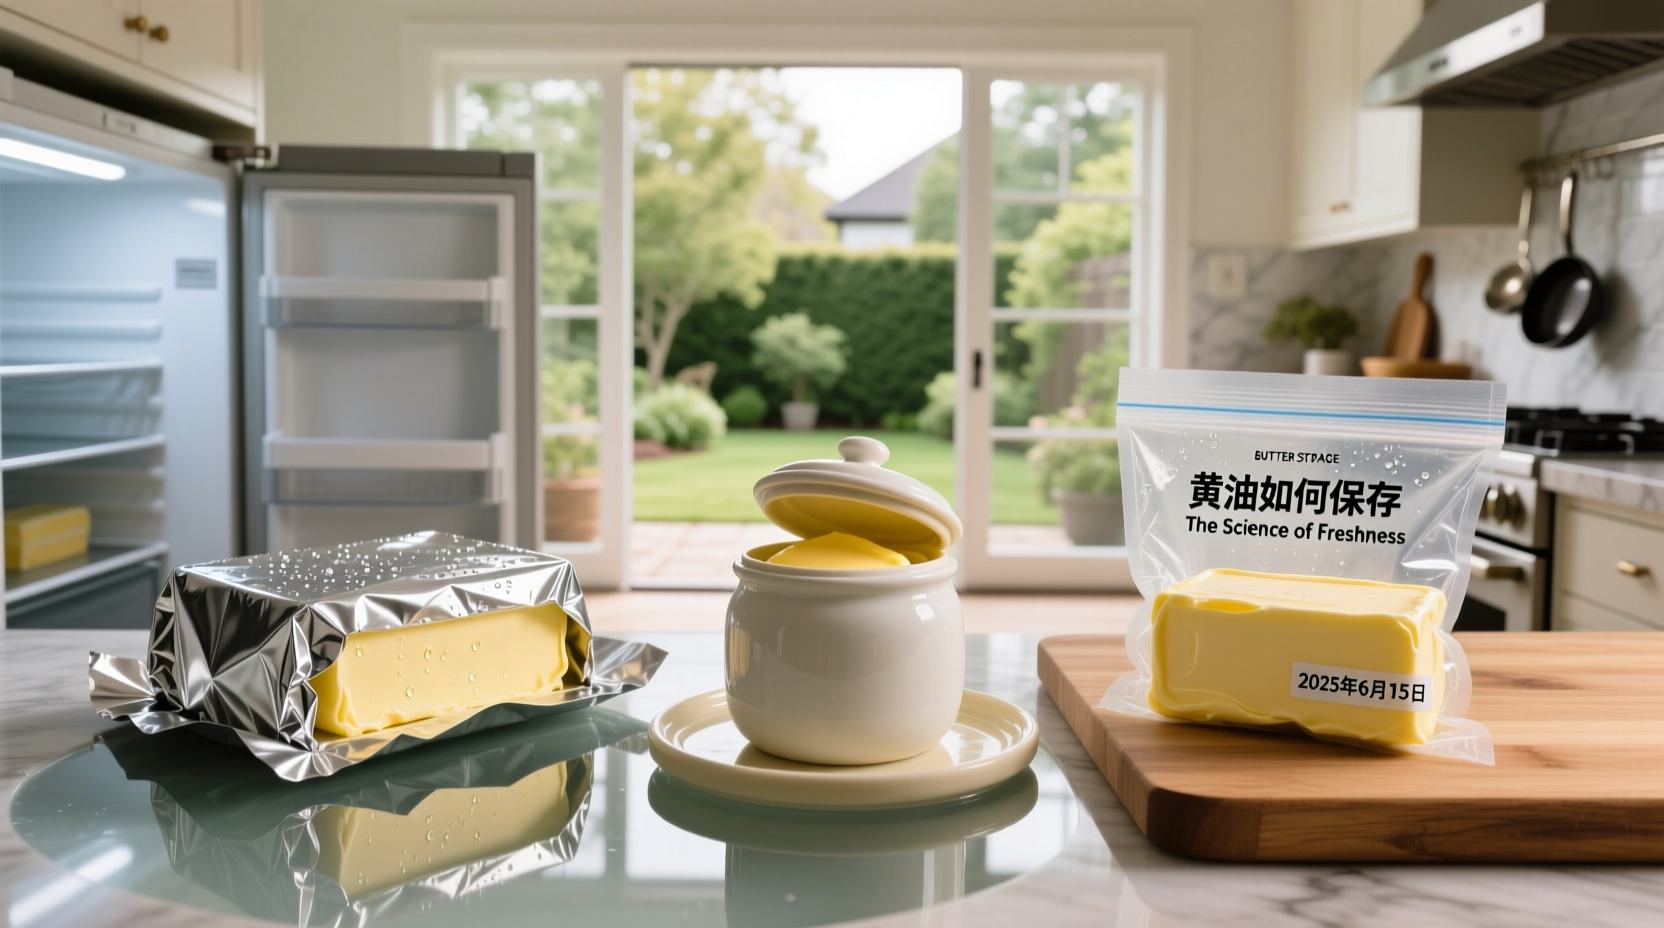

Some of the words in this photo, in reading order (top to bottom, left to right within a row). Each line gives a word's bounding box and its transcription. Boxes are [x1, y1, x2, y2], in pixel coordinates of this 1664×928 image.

[1254, 450, 1295, 462] BUTTER
[1189, 471, 1403, 517] 黄油如何保存
[1185, 515, 1218, 534] The
[1222, 518, 1289, 538] Science
[1293, 522, 1314, 540] of
[1317, 523, 1406, 545] Freshness
[1297, 672, 1426, 703] 2025年6月15日
